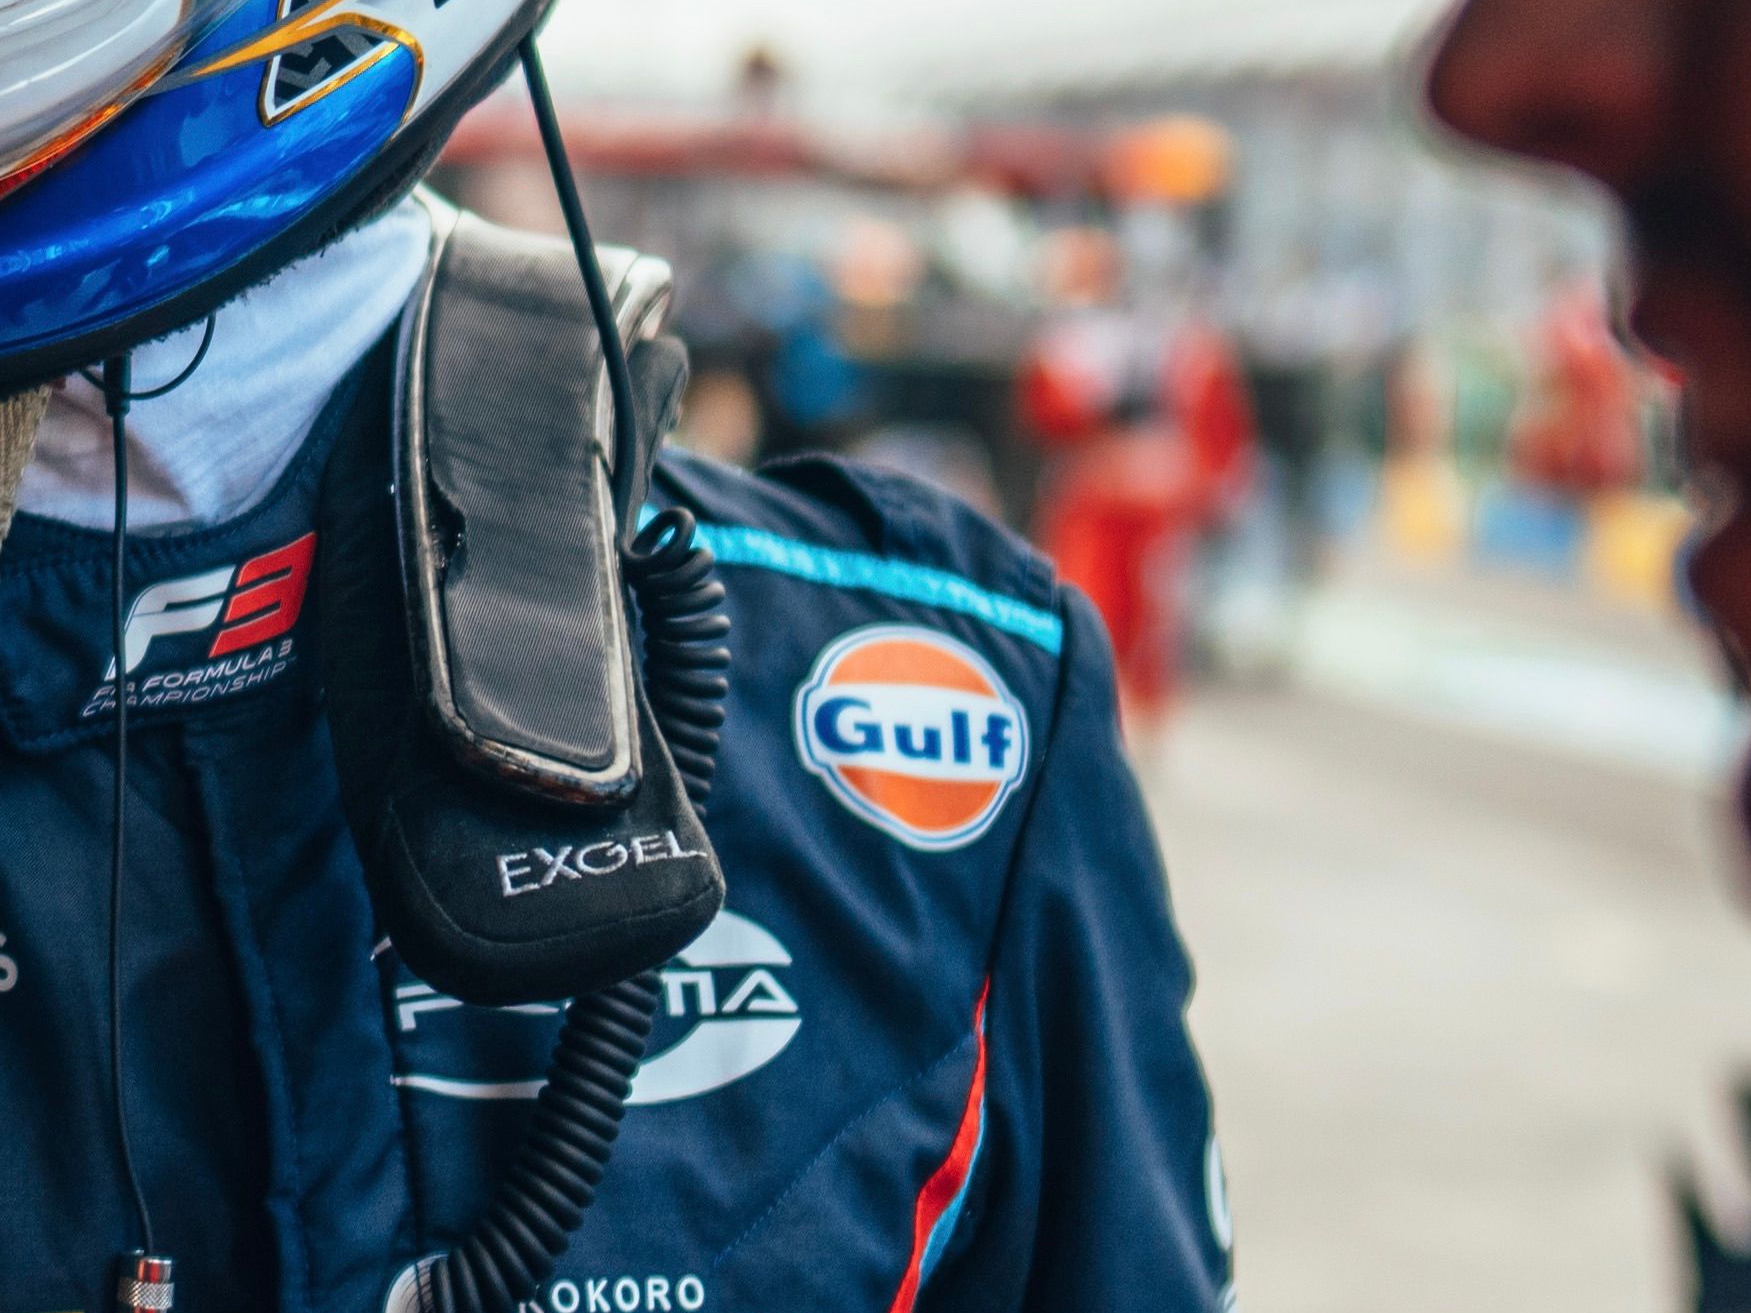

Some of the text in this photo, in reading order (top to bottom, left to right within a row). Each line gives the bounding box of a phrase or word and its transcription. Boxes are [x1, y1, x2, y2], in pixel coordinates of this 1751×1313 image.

[103, 530, 318, 682] F3
[82, 661, 288, 718] CHAMPIONSHIP
[142, 645, 273, 692] FORMULA
[277, 638, 294, 658] 3
[813, 696, 1013, 769] Gulf
[497, 829, 708, 898] EXGEL
